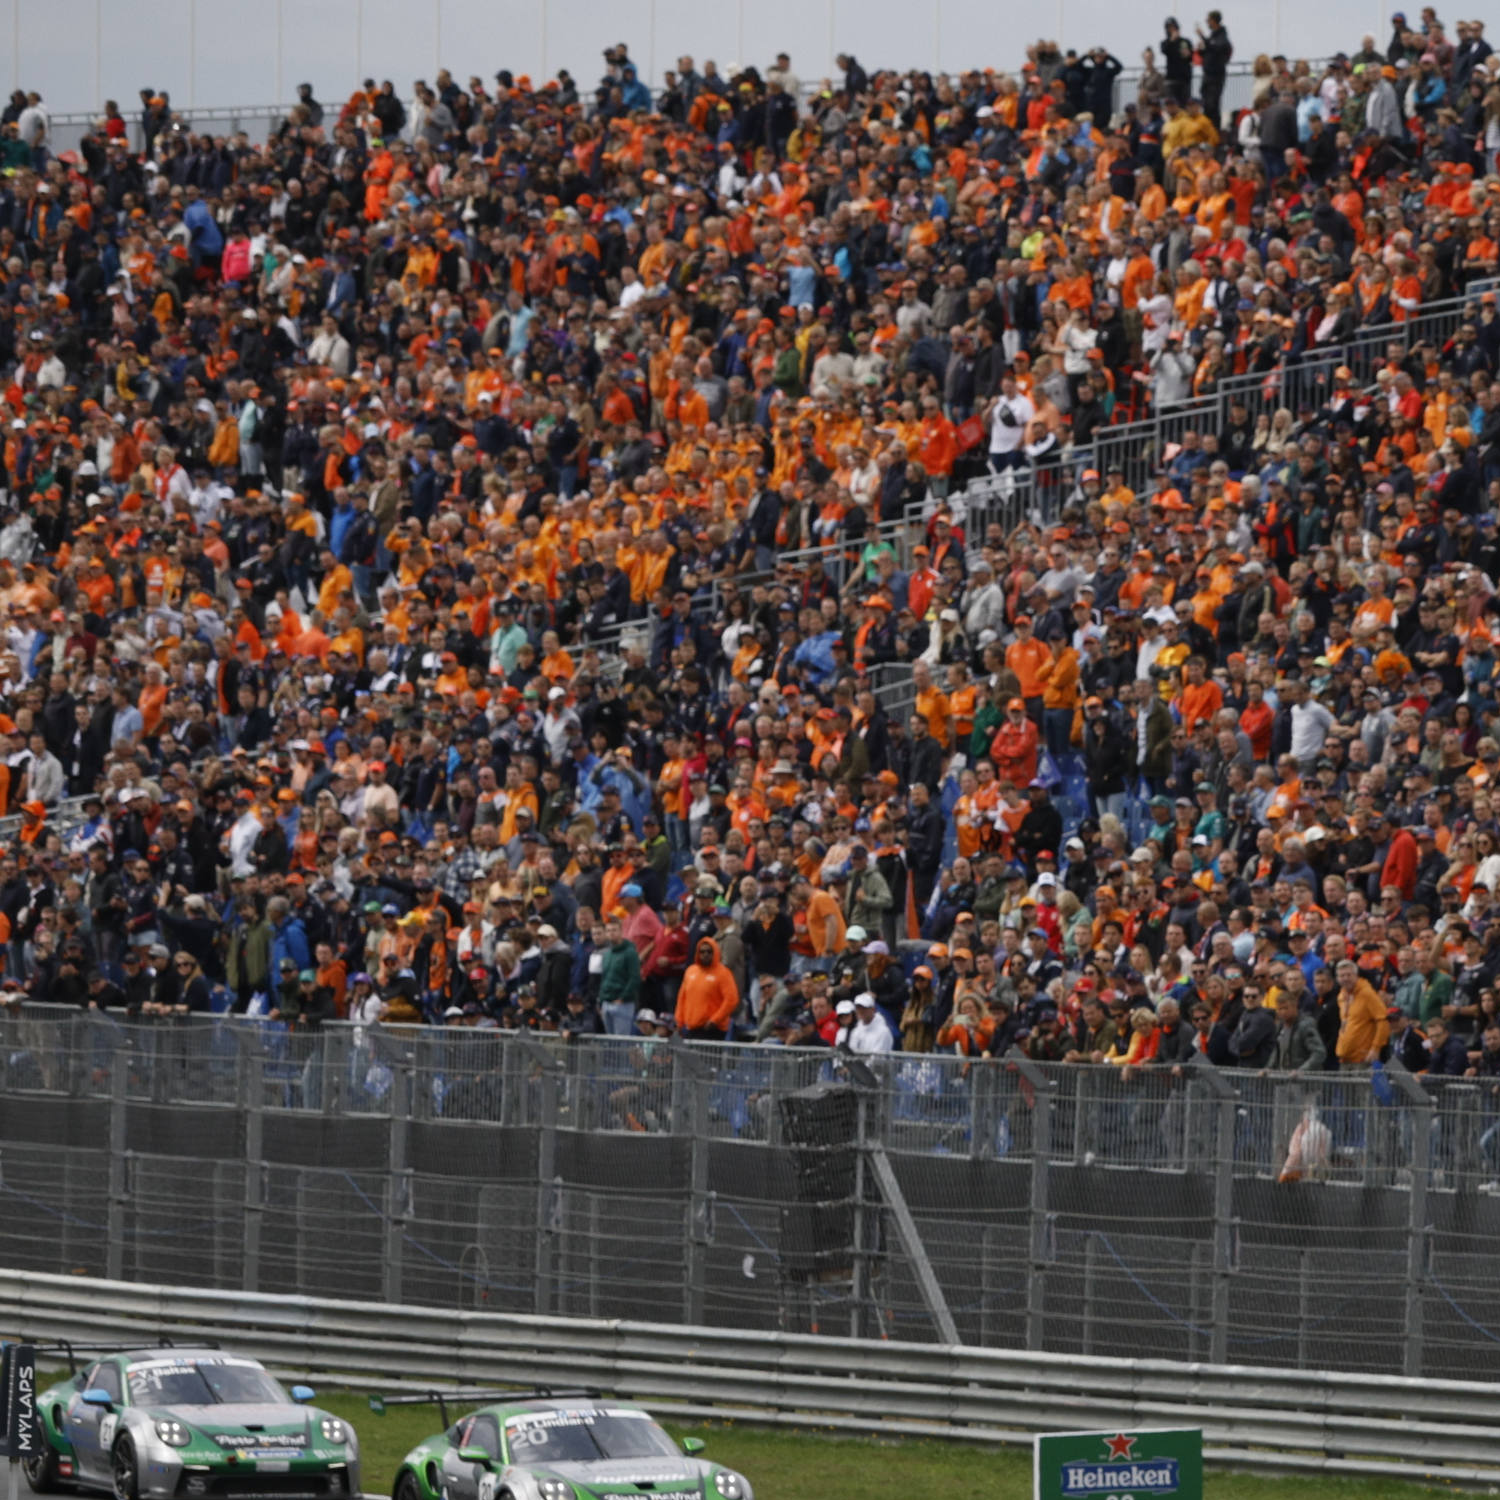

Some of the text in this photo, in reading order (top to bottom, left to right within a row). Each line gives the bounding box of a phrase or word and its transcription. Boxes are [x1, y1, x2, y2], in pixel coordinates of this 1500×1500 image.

[130, 1375, 164, 1396] 21
[18, 1365, 34, 1451] MYLAPS
[510, 1428, 548, 1450] 20
[1067, 1464, 1172, 1489] Heineken
